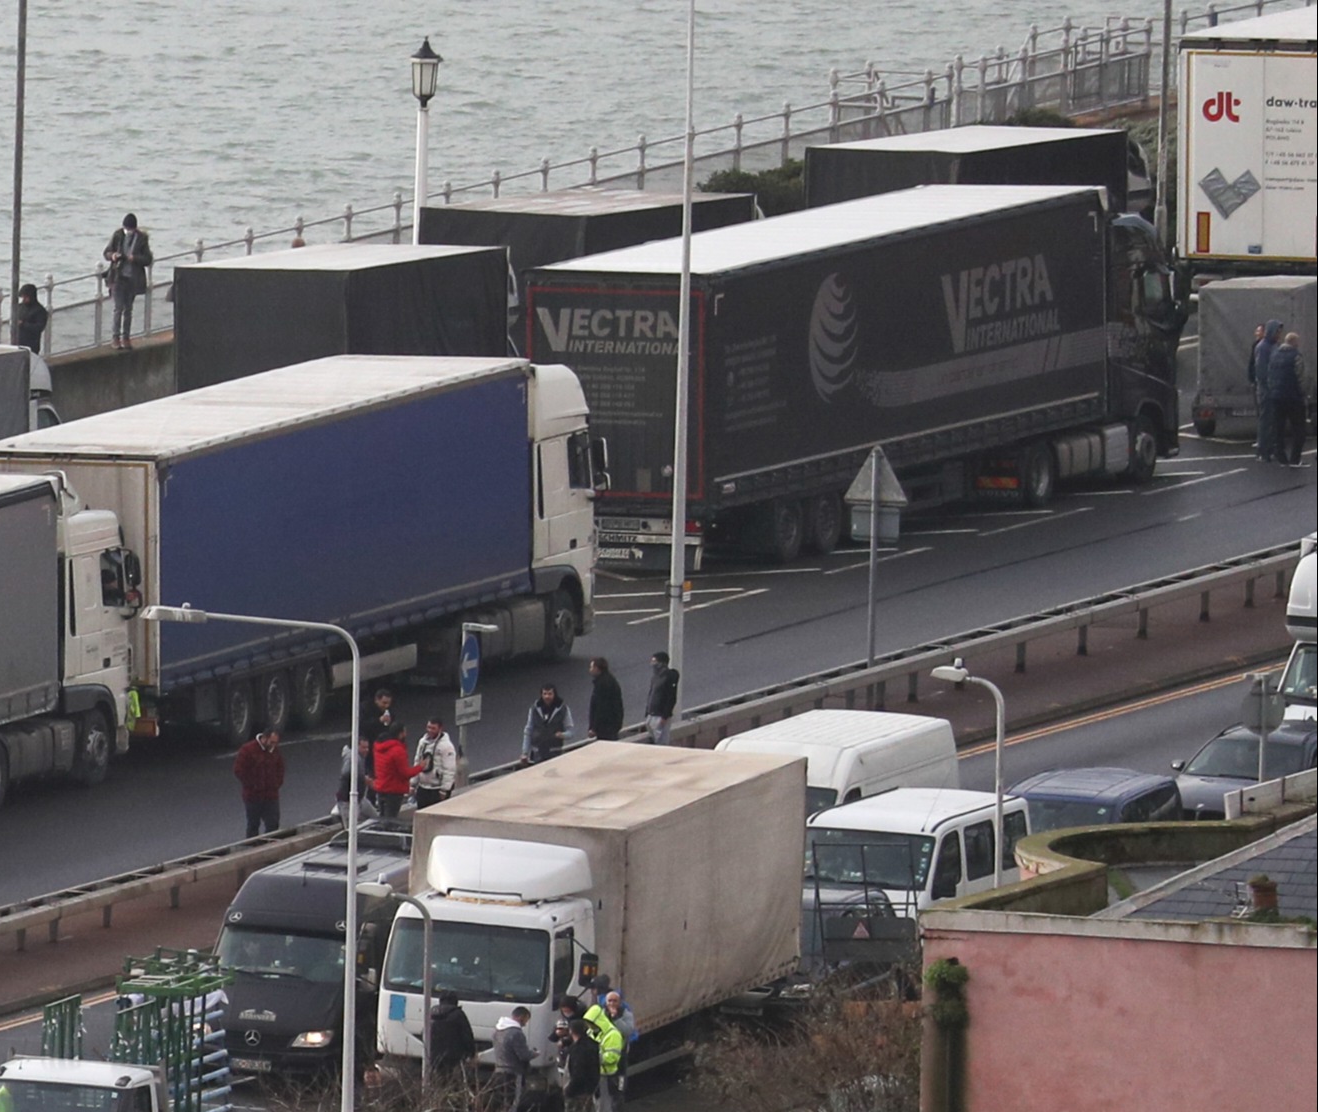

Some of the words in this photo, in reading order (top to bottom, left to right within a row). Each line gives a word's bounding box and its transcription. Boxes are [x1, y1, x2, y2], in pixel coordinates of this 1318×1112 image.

[941, 253, 1053, 353] VECTRA
[536, 307, 680, 351] VECTRA
[569, 340, 691, 356] INTERNATIONA
[967, 308, 1060, 349] INTERNATIONAL
